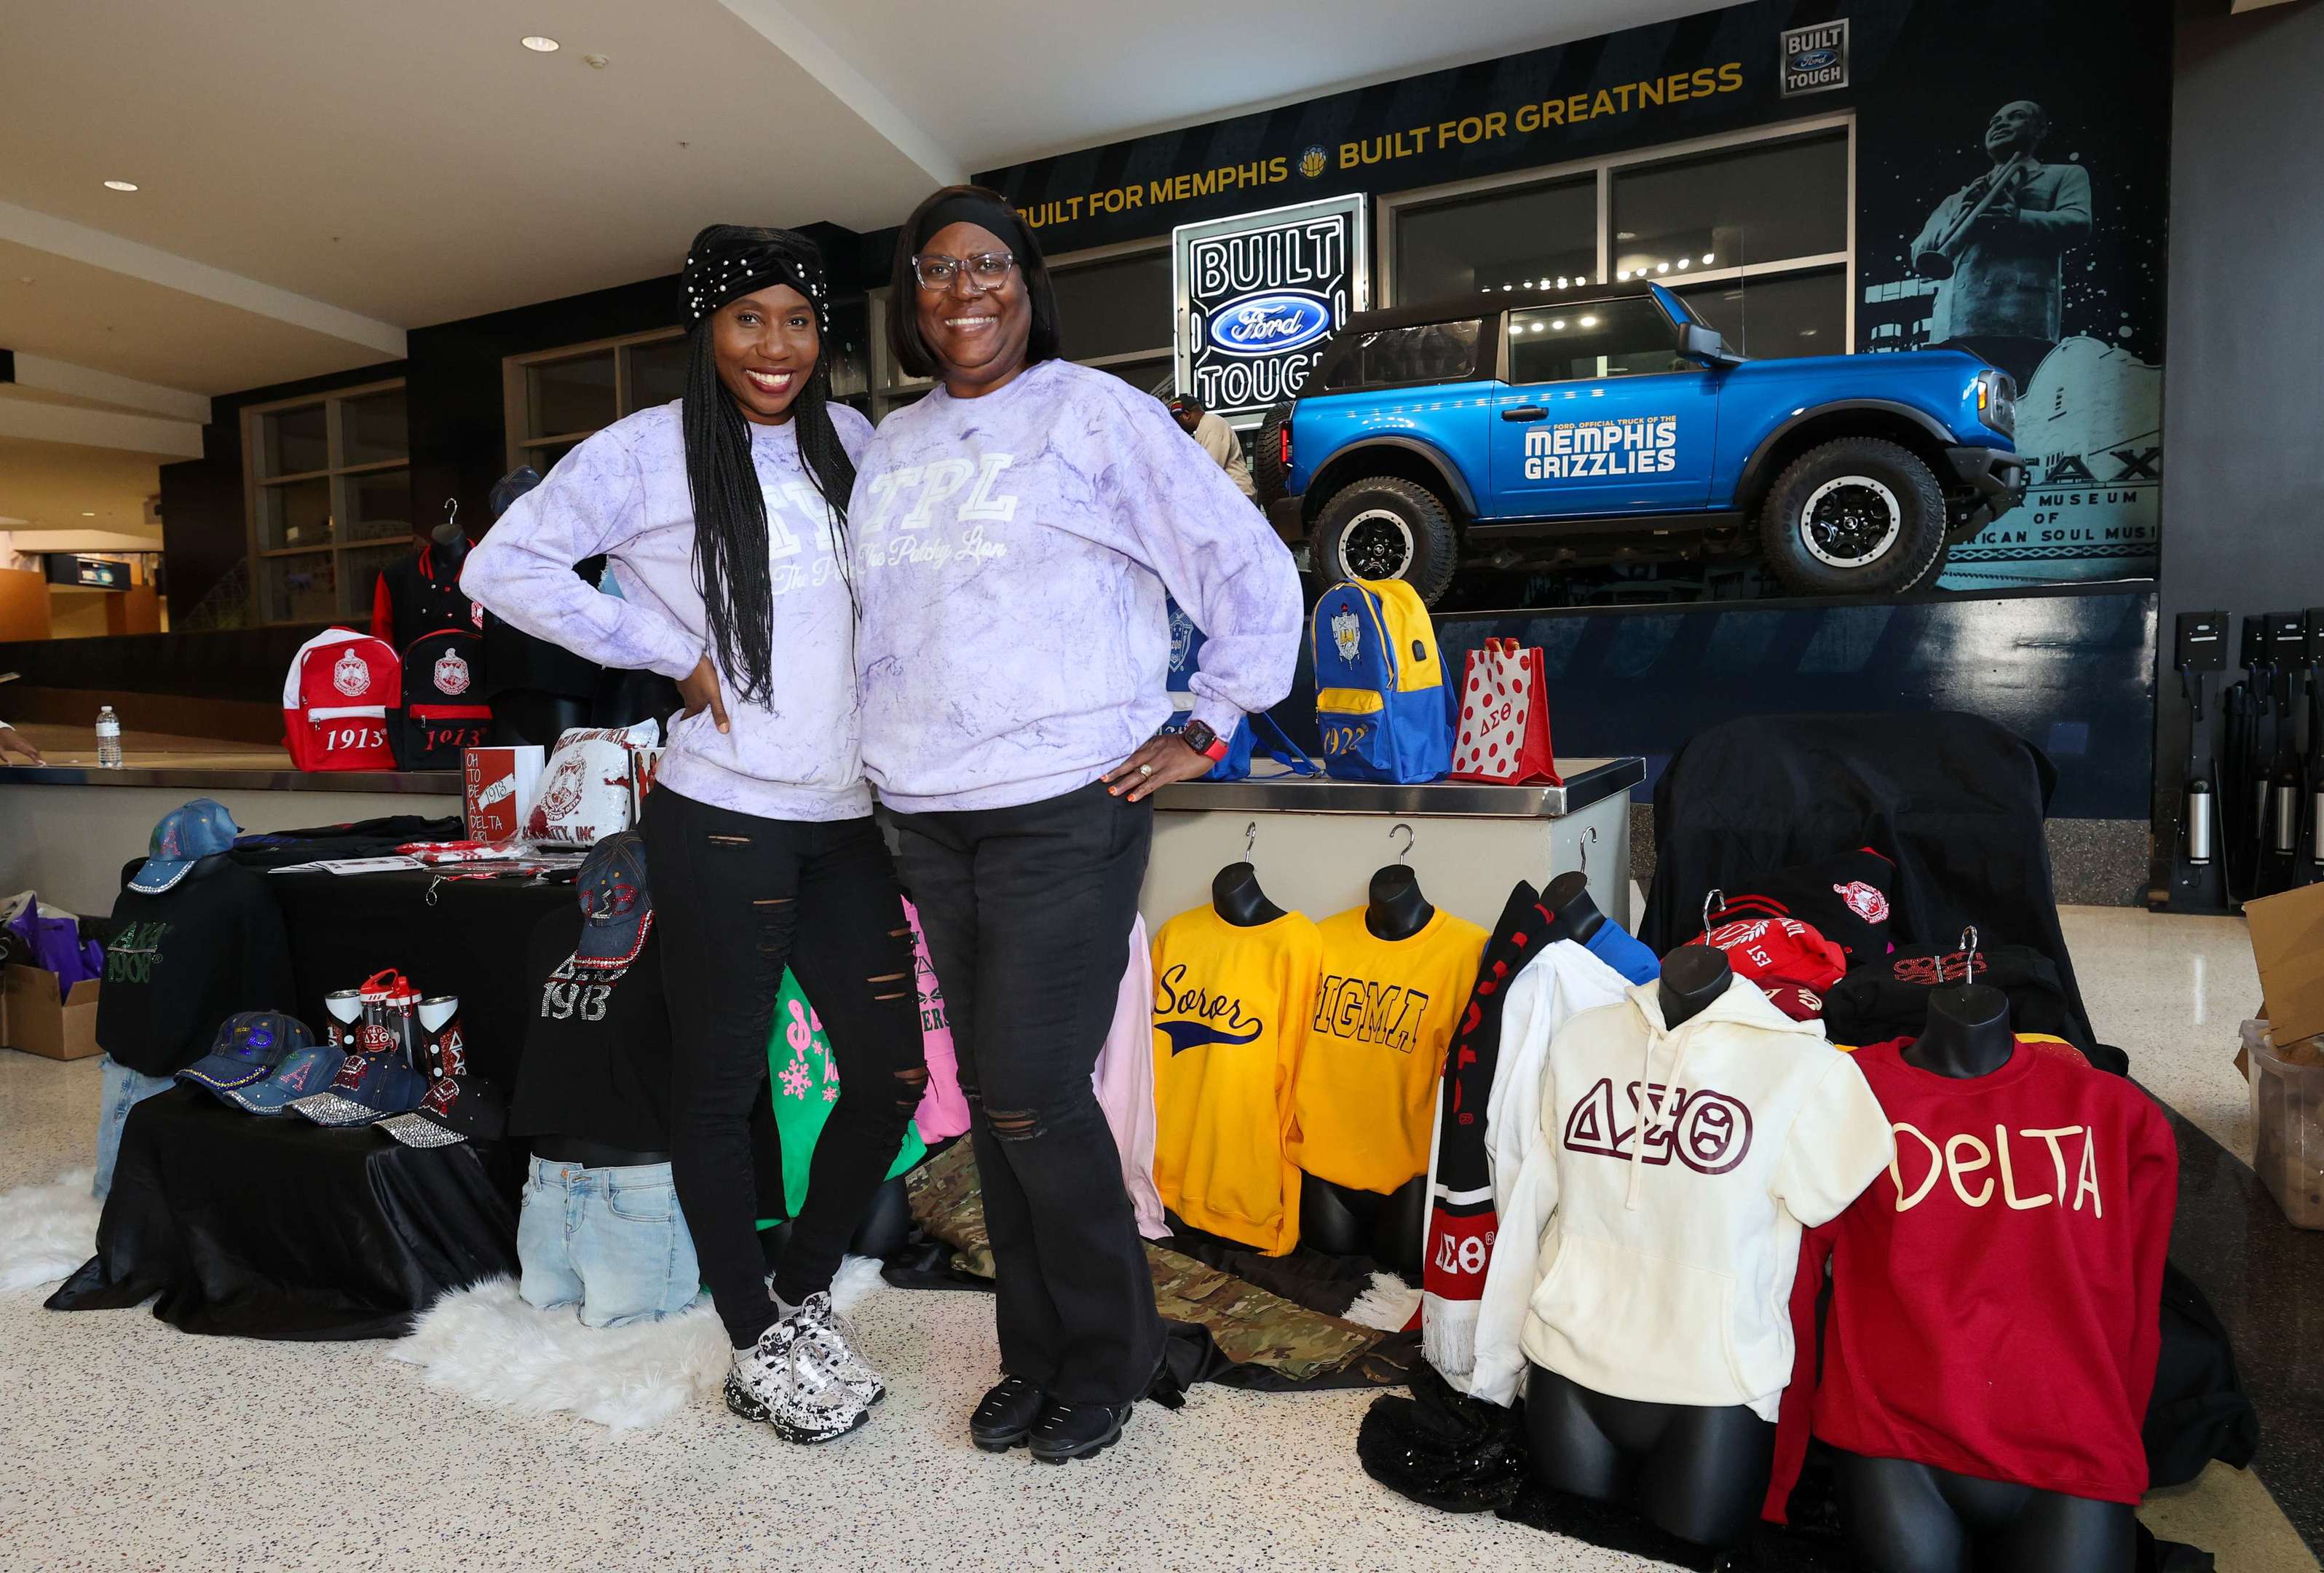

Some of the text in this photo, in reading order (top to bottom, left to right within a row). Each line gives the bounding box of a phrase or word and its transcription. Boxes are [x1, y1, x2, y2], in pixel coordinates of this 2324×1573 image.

[1788, 28, 1841, 55] BUILT
[1801, 53, 1827, 67] Ford
[1788, 66, 1841, 89] TOUGH
[1339, 62, 1744, 170] BUILT FOR GREATNESS
[1089, 185, 1143, 217] FOR
[1150, 157, 1288, 205] MEMPHIS
[1196, 221, 1340, 298] BUILT
[1230, 304, 1305, 342] Ford
[1198, 352, 1324, 409] TOUG
[1578, 420, 1615, 428] OFFICIAL
[1617, 417, 1644, 425] TRUCK
[1525, 422, 1677, 457] MEMPHIS
[1525, 448, 1676, 480] GRIZZLIES
[861, 452, 1018, 536] TPL
[2039, 491, 2137, 507] MUSEUM
[2034, 512, 2059, 524] OF
[2041, 528, 2094, 543] SOUL
[2105, 526, 2155, 540] MUSI
[1480, 702, 1511, 738] ΔΣΘ
[326, 728, 384, 751] 1913
[467, 753, 478, 767] OH
[467, 768, 481, 783] TO
[467, 784, 480, 798] BE
[486, 781, 507, 803] 1913
[469, 800, 476, 813] A
[470, 815, 503, 830] DELTA
[1747, 945, 1774, 968] EST
[1313, 973, 1429, 1054] IGMA
[365, 1032, 390, 1044] ΔΣΘ
[1564, 1078, 1753, 1175] ΔΣΘ
